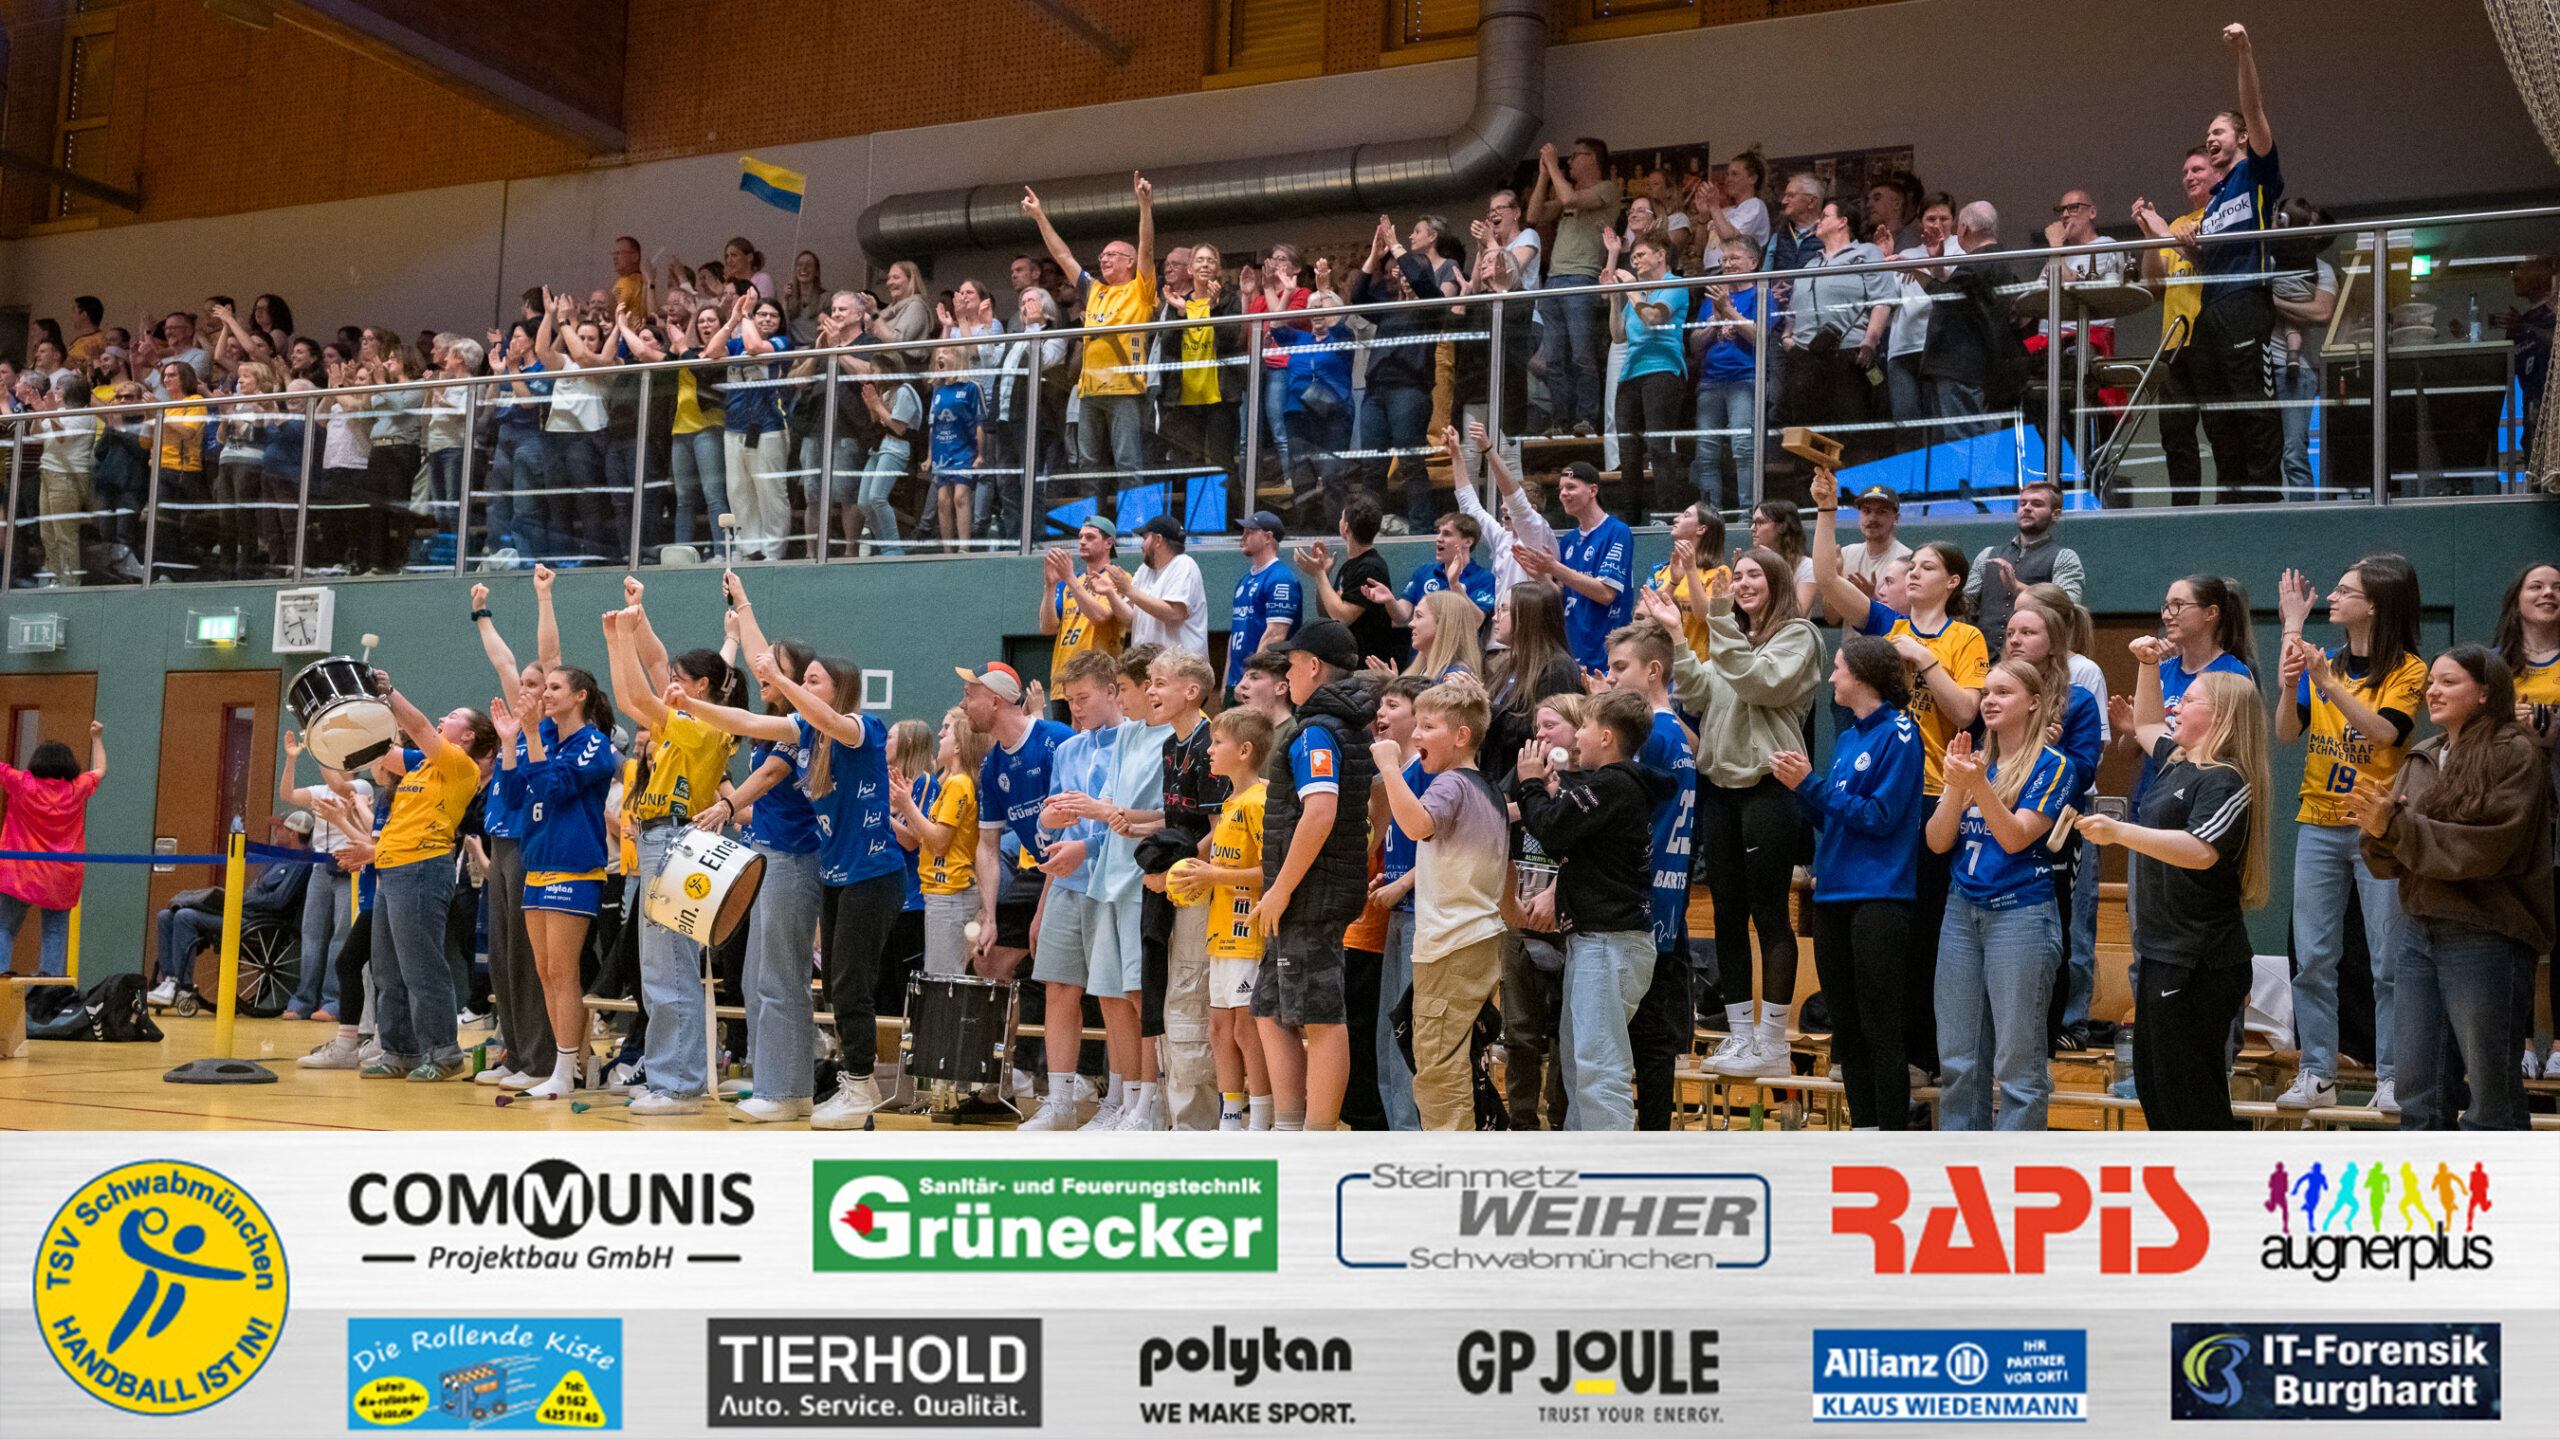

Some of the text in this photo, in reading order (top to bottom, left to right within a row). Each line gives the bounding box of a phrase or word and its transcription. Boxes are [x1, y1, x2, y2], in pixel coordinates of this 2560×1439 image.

[1061, 628, 1082, 647] 26
[2308, 743, 2372, 765] SCHNEIDER
[2310, 733, 2375, 754] MARKGRAF
[2325, 762, 2358, 794] 19
[532, 802, 544, 823] 6
[698, 839, 739, 872] Eine
[1965, 839, 1983, 876] 7
[1652, 869, 1688, 890] BARTS
[1223, 1110, 1243, 1120] SMÜ
